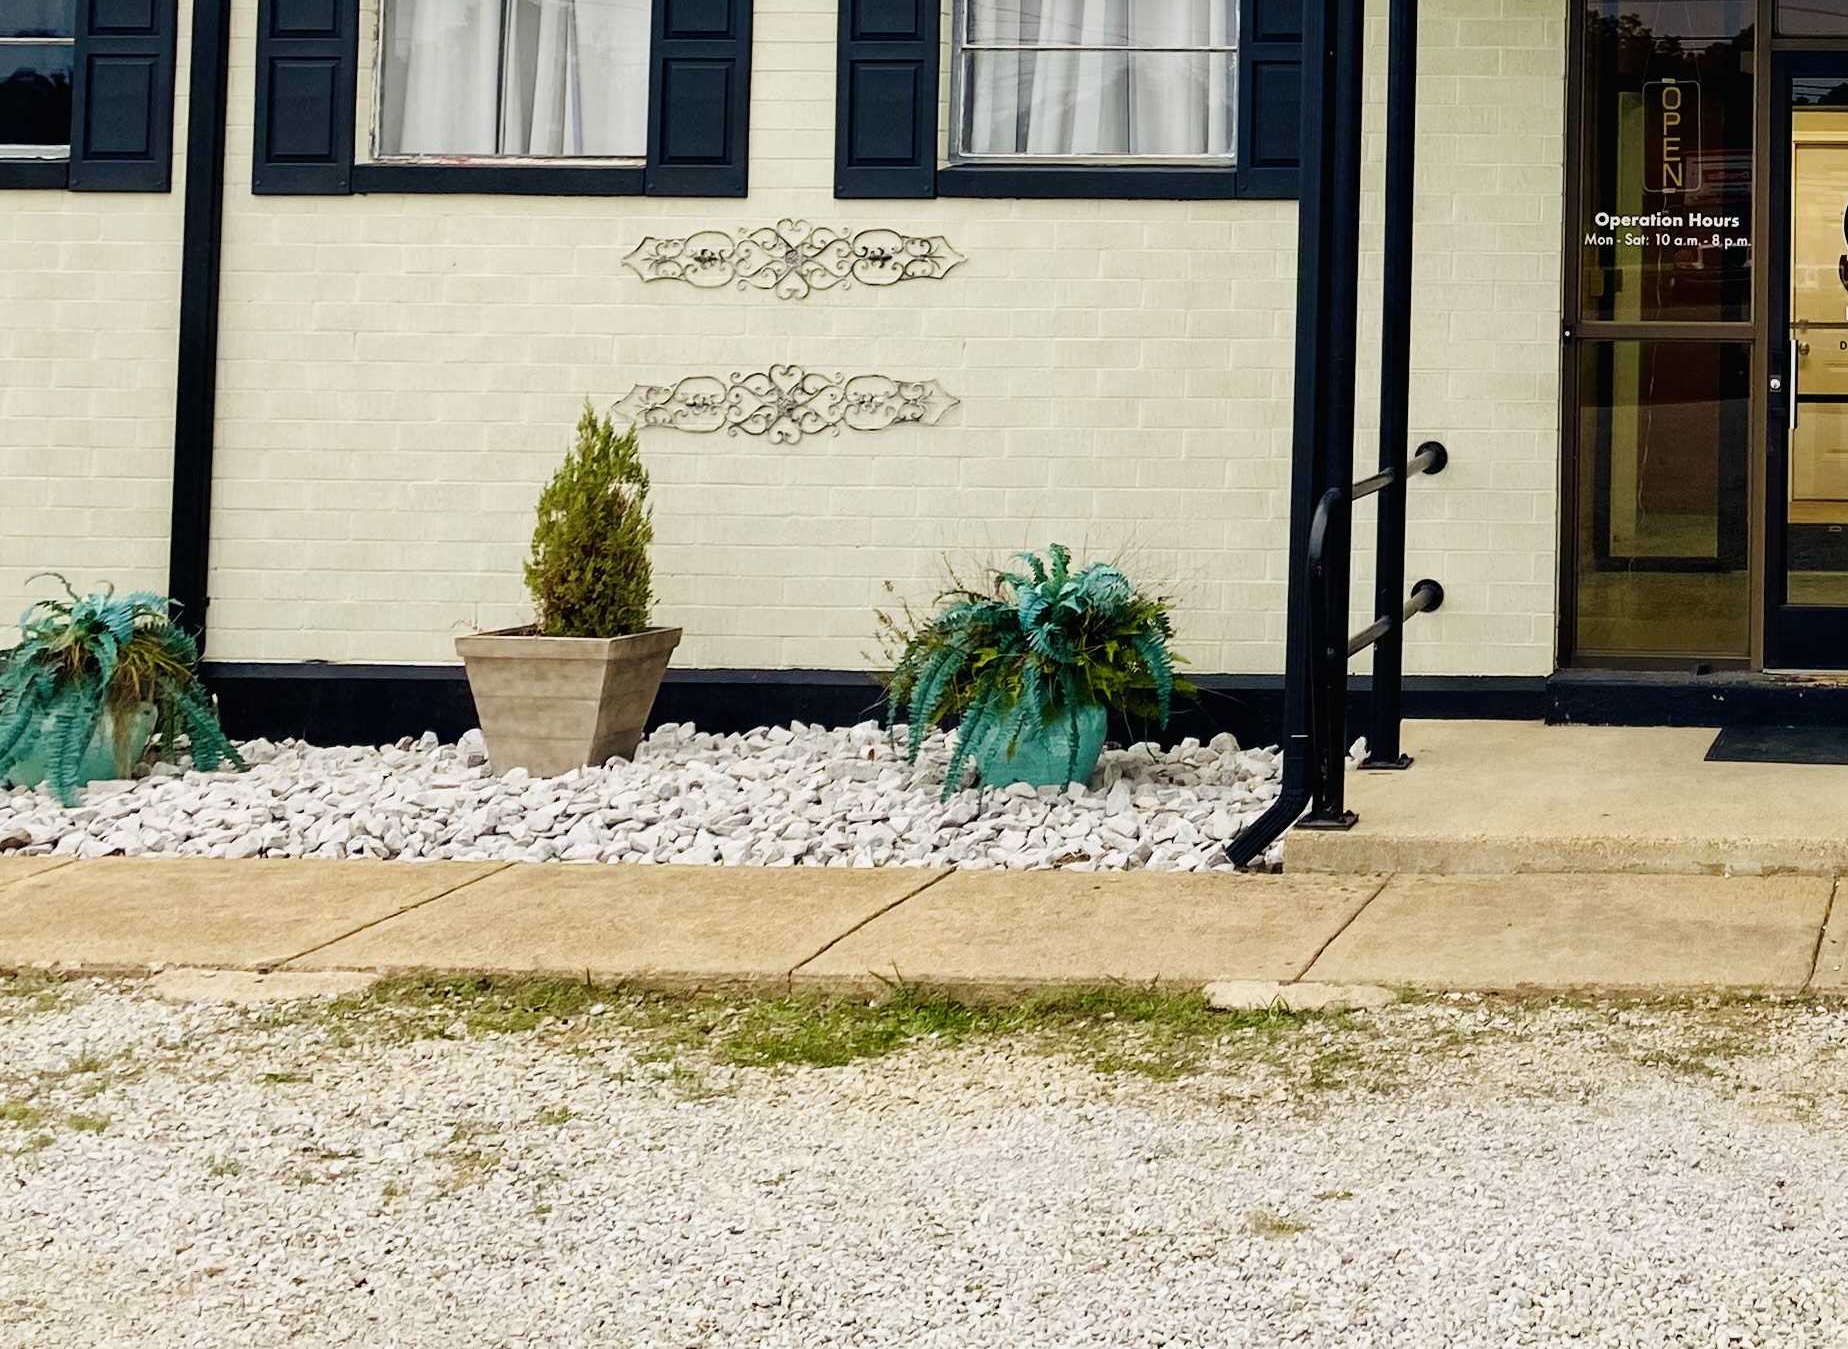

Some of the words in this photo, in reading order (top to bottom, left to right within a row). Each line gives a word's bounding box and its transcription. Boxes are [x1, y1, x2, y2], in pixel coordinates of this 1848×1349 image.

[1662, 87, 1682, 187] OPEN
[1594, 211, 1683, 231] Operation
[1688, 212, 1740, 228] Hours
[1584, 233, 1613, 246] Mon
[1624, 233, 1650, 246] Sat:
[1655, 233, 1670, 246] 10
[1674, 237, 1702, 247] a.m.
[1711, 233, 1720, 247] 8
[1724, 237, 1752, 250] p.m.
